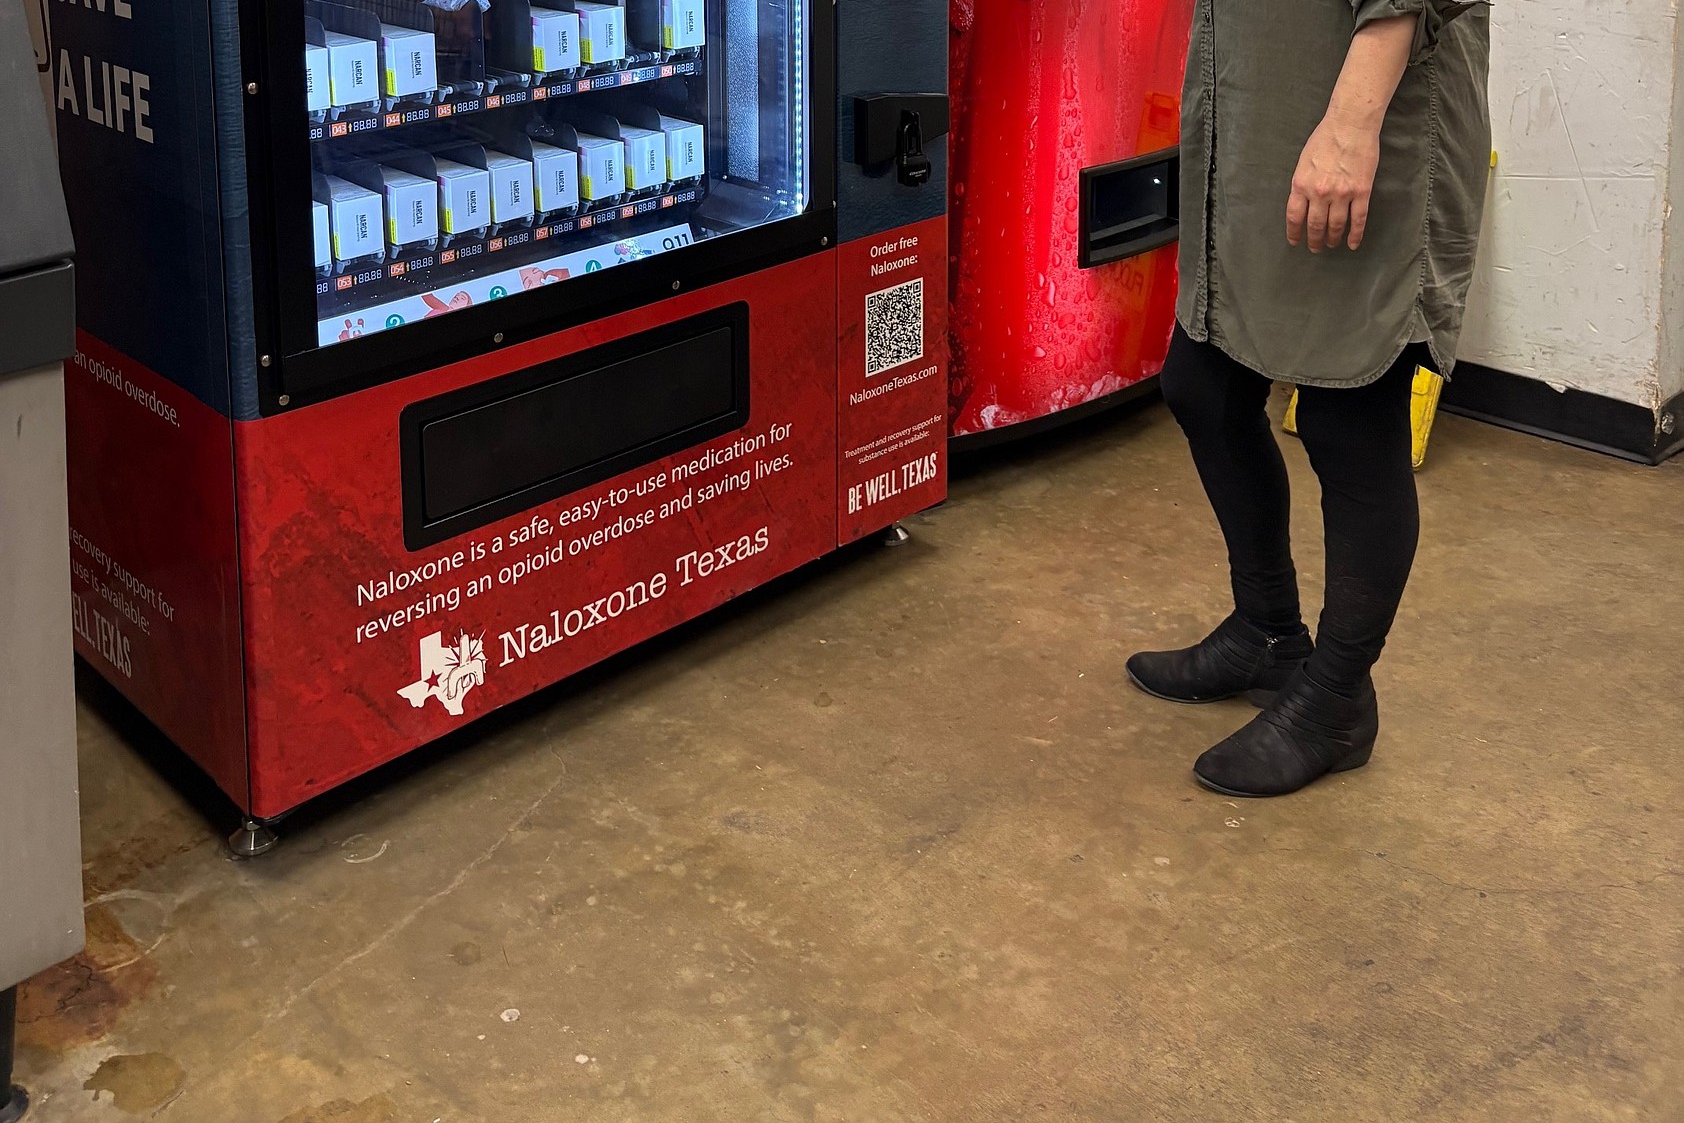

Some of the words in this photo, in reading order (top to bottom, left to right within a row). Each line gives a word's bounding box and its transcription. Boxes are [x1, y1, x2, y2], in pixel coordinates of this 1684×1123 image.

[355, 60, 363, 86] NARCAN
[413, 51, 423, 77] NARCAN
[57, 48, 80, 116] A
[83, 55, 154, 144] LIFE
[331, 123, 347, 136] 043
[415, 200, 423, 225] NARCAN
[512, 180, 520, 204] NARCAN
[359, 214, 368, 239] NARCAN
[870, 241, 898, 258] Order
[899, 236, 918, 250] free
[337, 276, 353, 290] 053
[870, 254, 918, 277] Naloxone:
[74, 349, 87, 369] an
[88, 358, 123, 392] opioid
[124, 380, 180, 428] overdose.
[849, 365, 938, 406] NaloxoneTexas.com
[844, 442, 875, 459] Treatment
[875, 436, 887, 448] and
[887, 426, 912, 443] recovery
[911, 419, 934, 433] support
[933, 414, 942, 423] for
[858, 448, 888, 465] substance
[887, 443, 898, 453] use
[898, 440, 904, 448] is
[903, 430, 930, 447] available:
[848, 483, 863, 515] BE
[865, 469, 902, 507] WELL,
[901, 452, 937, 491] TEXAS
[356, 550, 465, 607] Naloxone
[470, 541, 486, 563] is
[491, 536, 503, 554] a
[509, 515, 554, 547] safe,
[559, 472, 667, 527] easy-to-use
[671, 432, 766, 483] medication
[769, 422, 793, 444] for
[356, 586, 460, 644] reversing
[466, 574, 492, 598] an
[497, 539, 564, 585] opioid
[568, 509, 655, 557] overdose
[659, 488, 692, 519] and
[697, 470, 751, 504] saving
[755, 454, 794, 480] lives.
[72, 558, 90, 584] use
[90, 569, 100, 592] is
[101, 582, 151, 636] available:
[113, 561, 157, 608] support
[157, 592, 175, 622] for
[498, 573, 668, 668] Naloxone
[676, 526, 769, 587] Texas
[92, 609, 132, 679] TEXAS
